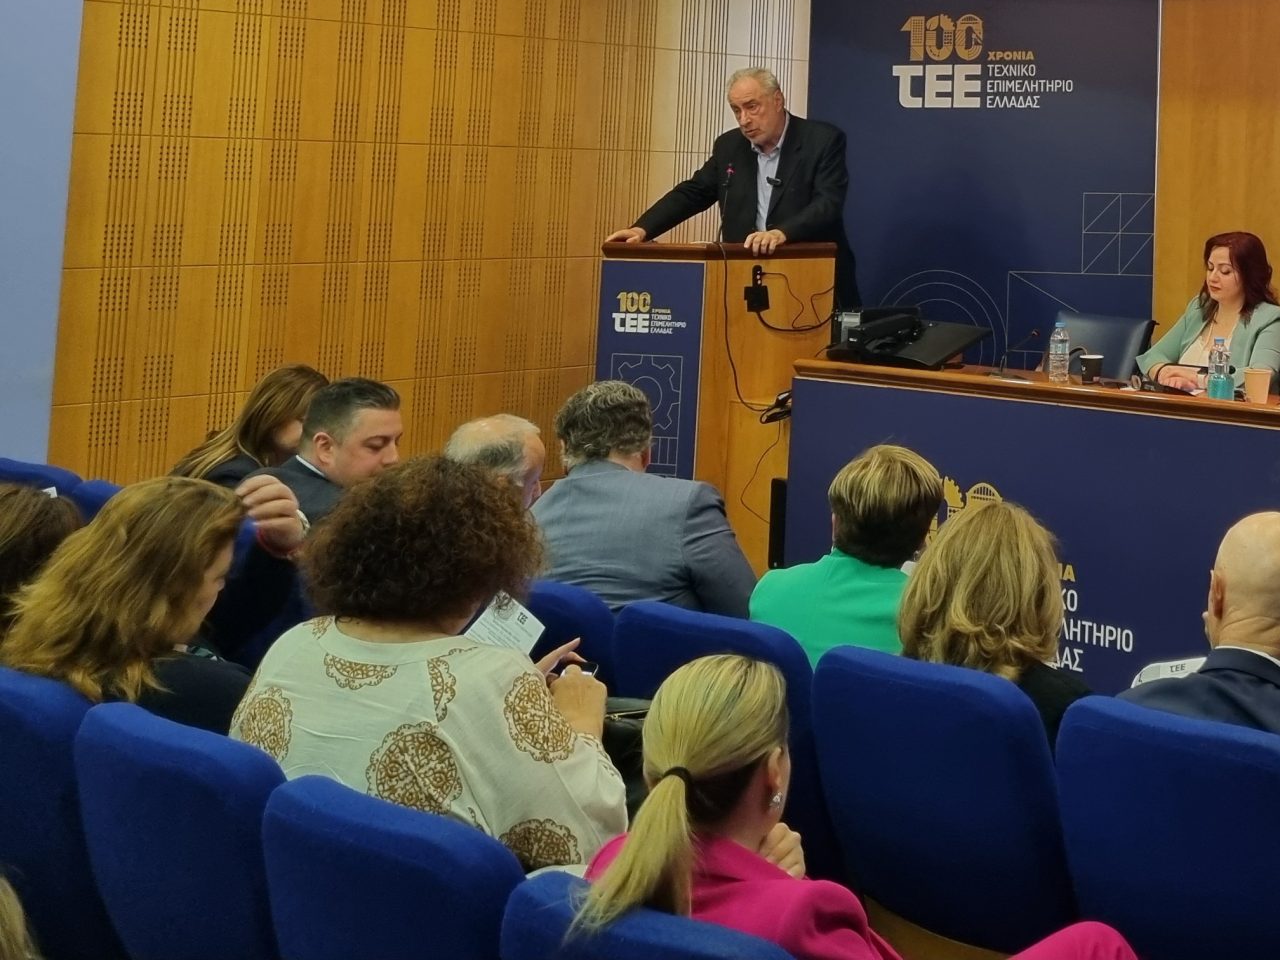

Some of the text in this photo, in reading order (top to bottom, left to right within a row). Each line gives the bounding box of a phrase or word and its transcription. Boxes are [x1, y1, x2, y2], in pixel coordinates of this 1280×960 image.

[899, 13, 984, 61] 100
[987, 51, 1035, 61] ΧΡΟΝΙΑ
[986, 64, 1037, 77] ΤΕΧΝΙΚΟ
[986, 79, 1074, 93] ΕΠΙΜΕΛΗΤΗΡΙΟ
[986, 95, 1041, 109] ΕΛΛΑΔΑΣ
[616, 291, 651, 313] 100
[1060, 617, 1134, 653] ΛΗΤΗΡΙΟ
